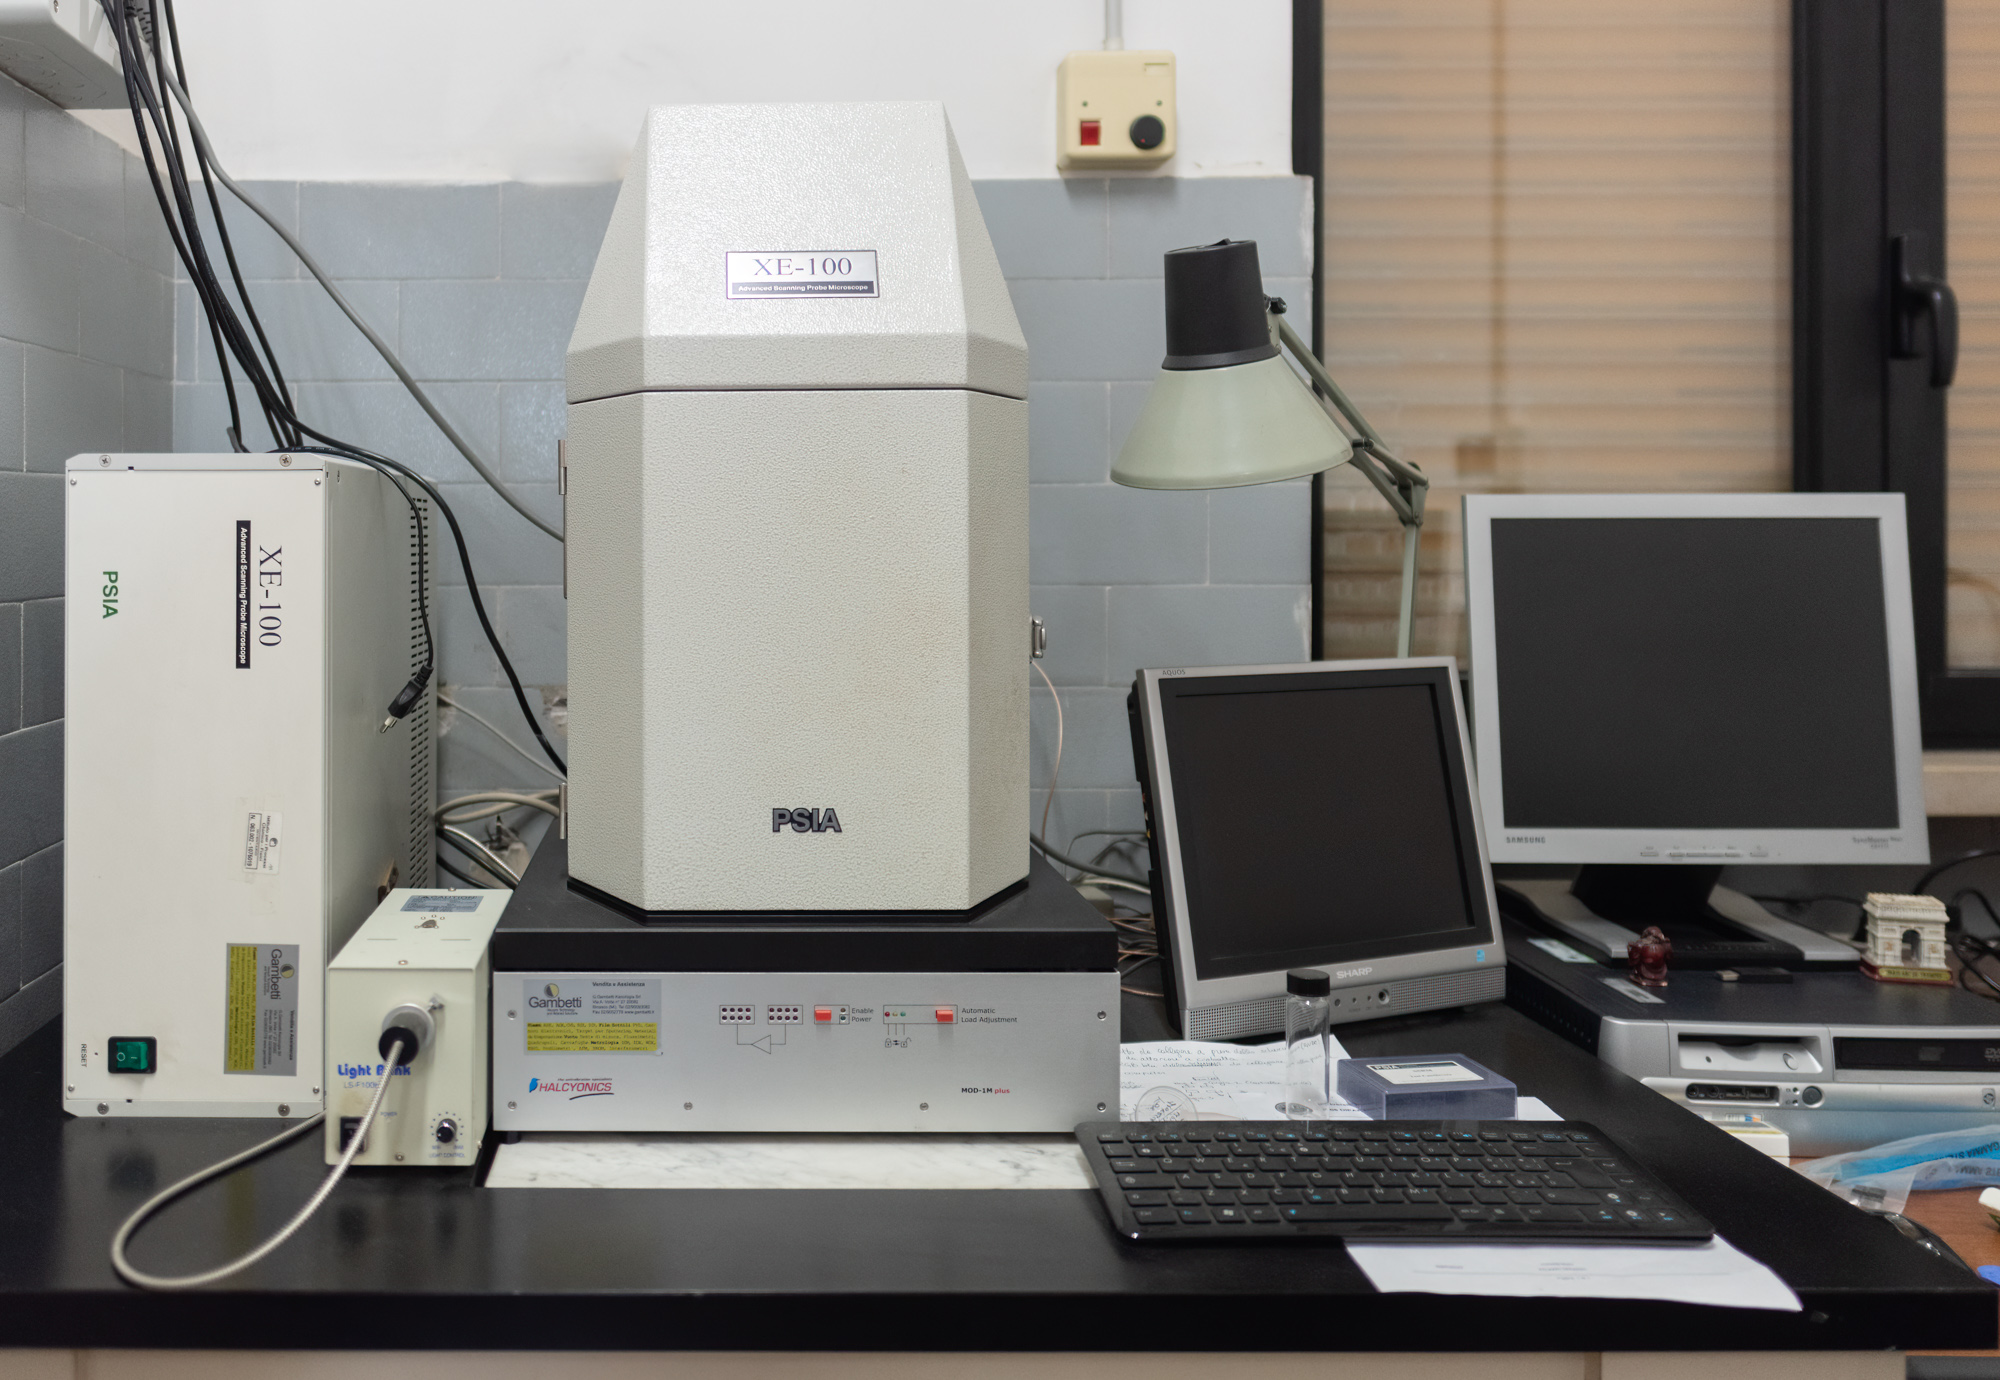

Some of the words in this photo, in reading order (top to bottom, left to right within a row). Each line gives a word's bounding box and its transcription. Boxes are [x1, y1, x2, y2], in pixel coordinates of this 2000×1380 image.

[754, 257, 852, 276] XE-100
[240, 527, 248, 563] Advanced
[238, 565, 248, 599] Scanning
[102, 571, 119, 619] PSIA
[259, 545, 282, 647] XE-100
[240, 600, 248, 621] Probe
[238, 622, 248, 664] Microscope
[1162, 669, 1186, 677] AQUOS
[772, 807, 843, 833] PSIA
[1506, 836, 1546, 844] SAMSUNG
[270, 949, 283, 1000] Gambetti
[1336, 967, 1373, 979] SHARP
[528, 996, 582, 1008] Gambetti
[979, 1016, 1017, 1024] Adjustment
[337, 1063, 371, 1079] Light
[376, 1064, 411, 1076] Bnk
[539, 1082, 612, 1092] HALCYONICS
[994, 1087, 1010, 1095] plus
[1967, 1141, 2000, 1158] GAMMA
